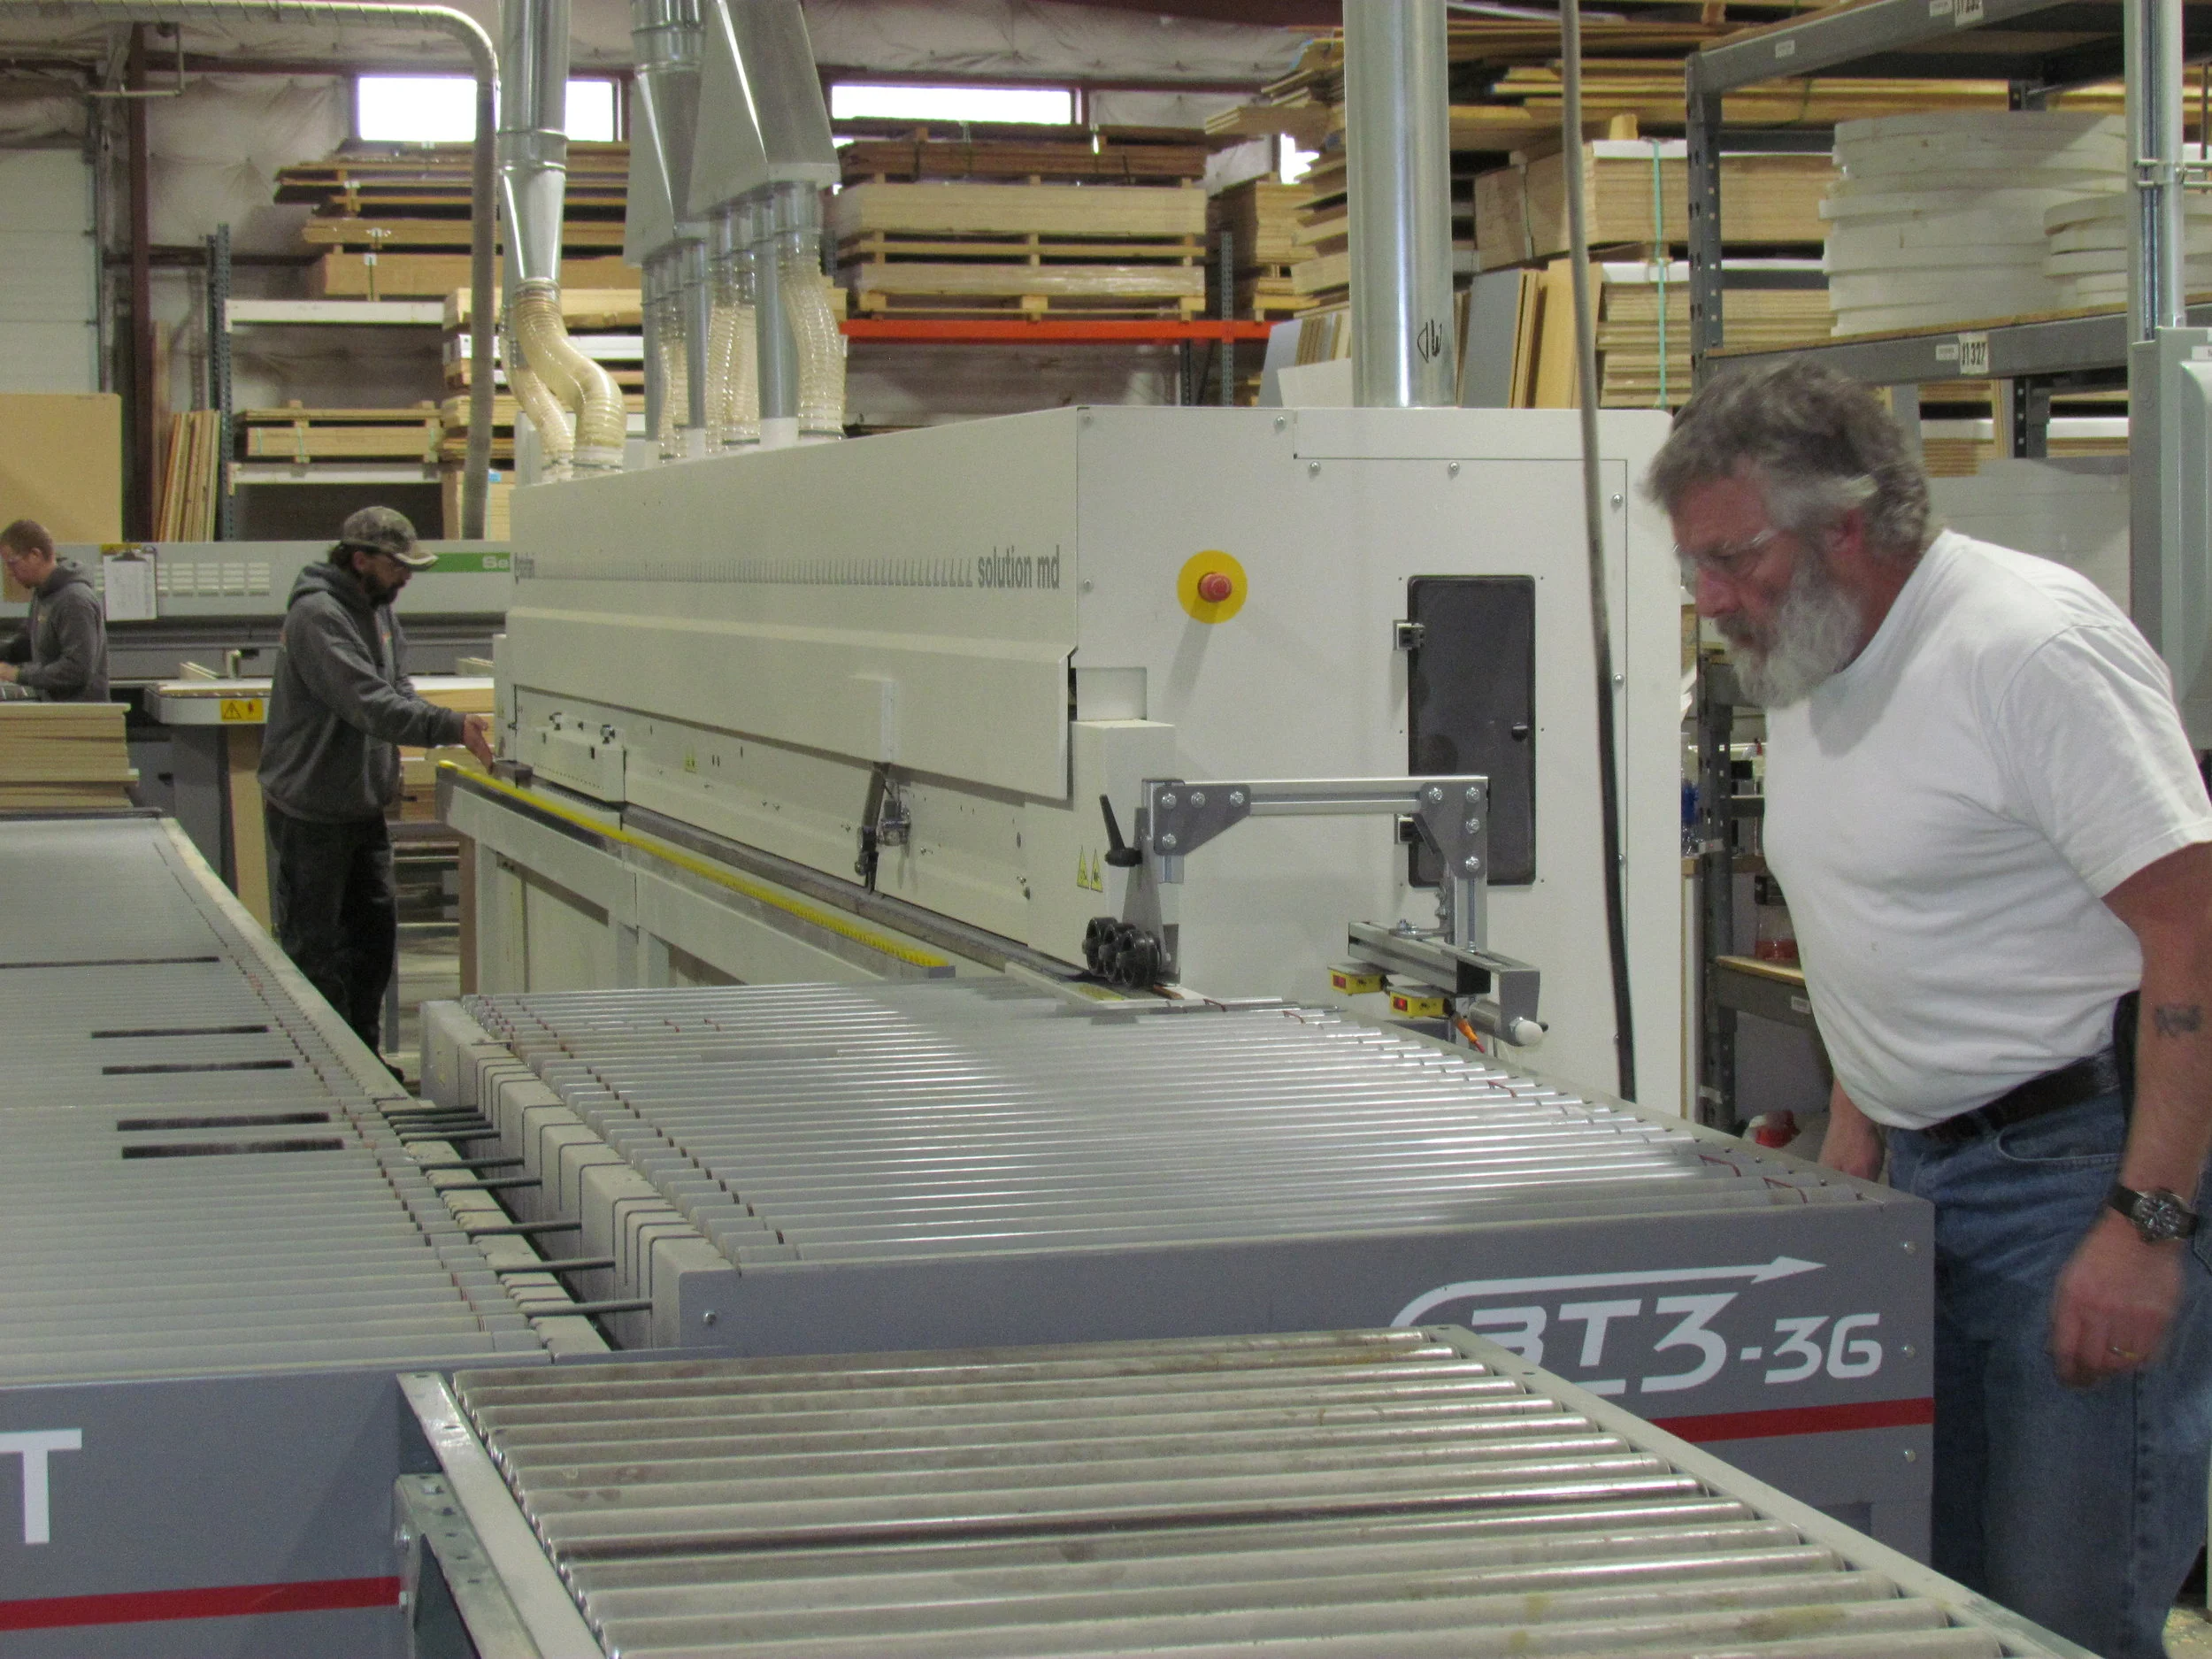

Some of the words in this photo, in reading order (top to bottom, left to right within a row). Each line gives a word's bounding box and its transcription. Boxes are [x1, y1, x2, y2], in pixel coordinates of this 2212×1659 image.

[978, 544, 1032, 588] solution
[1037, 544, 1060, 589] md
[0, 1428, 82, 1544] T
